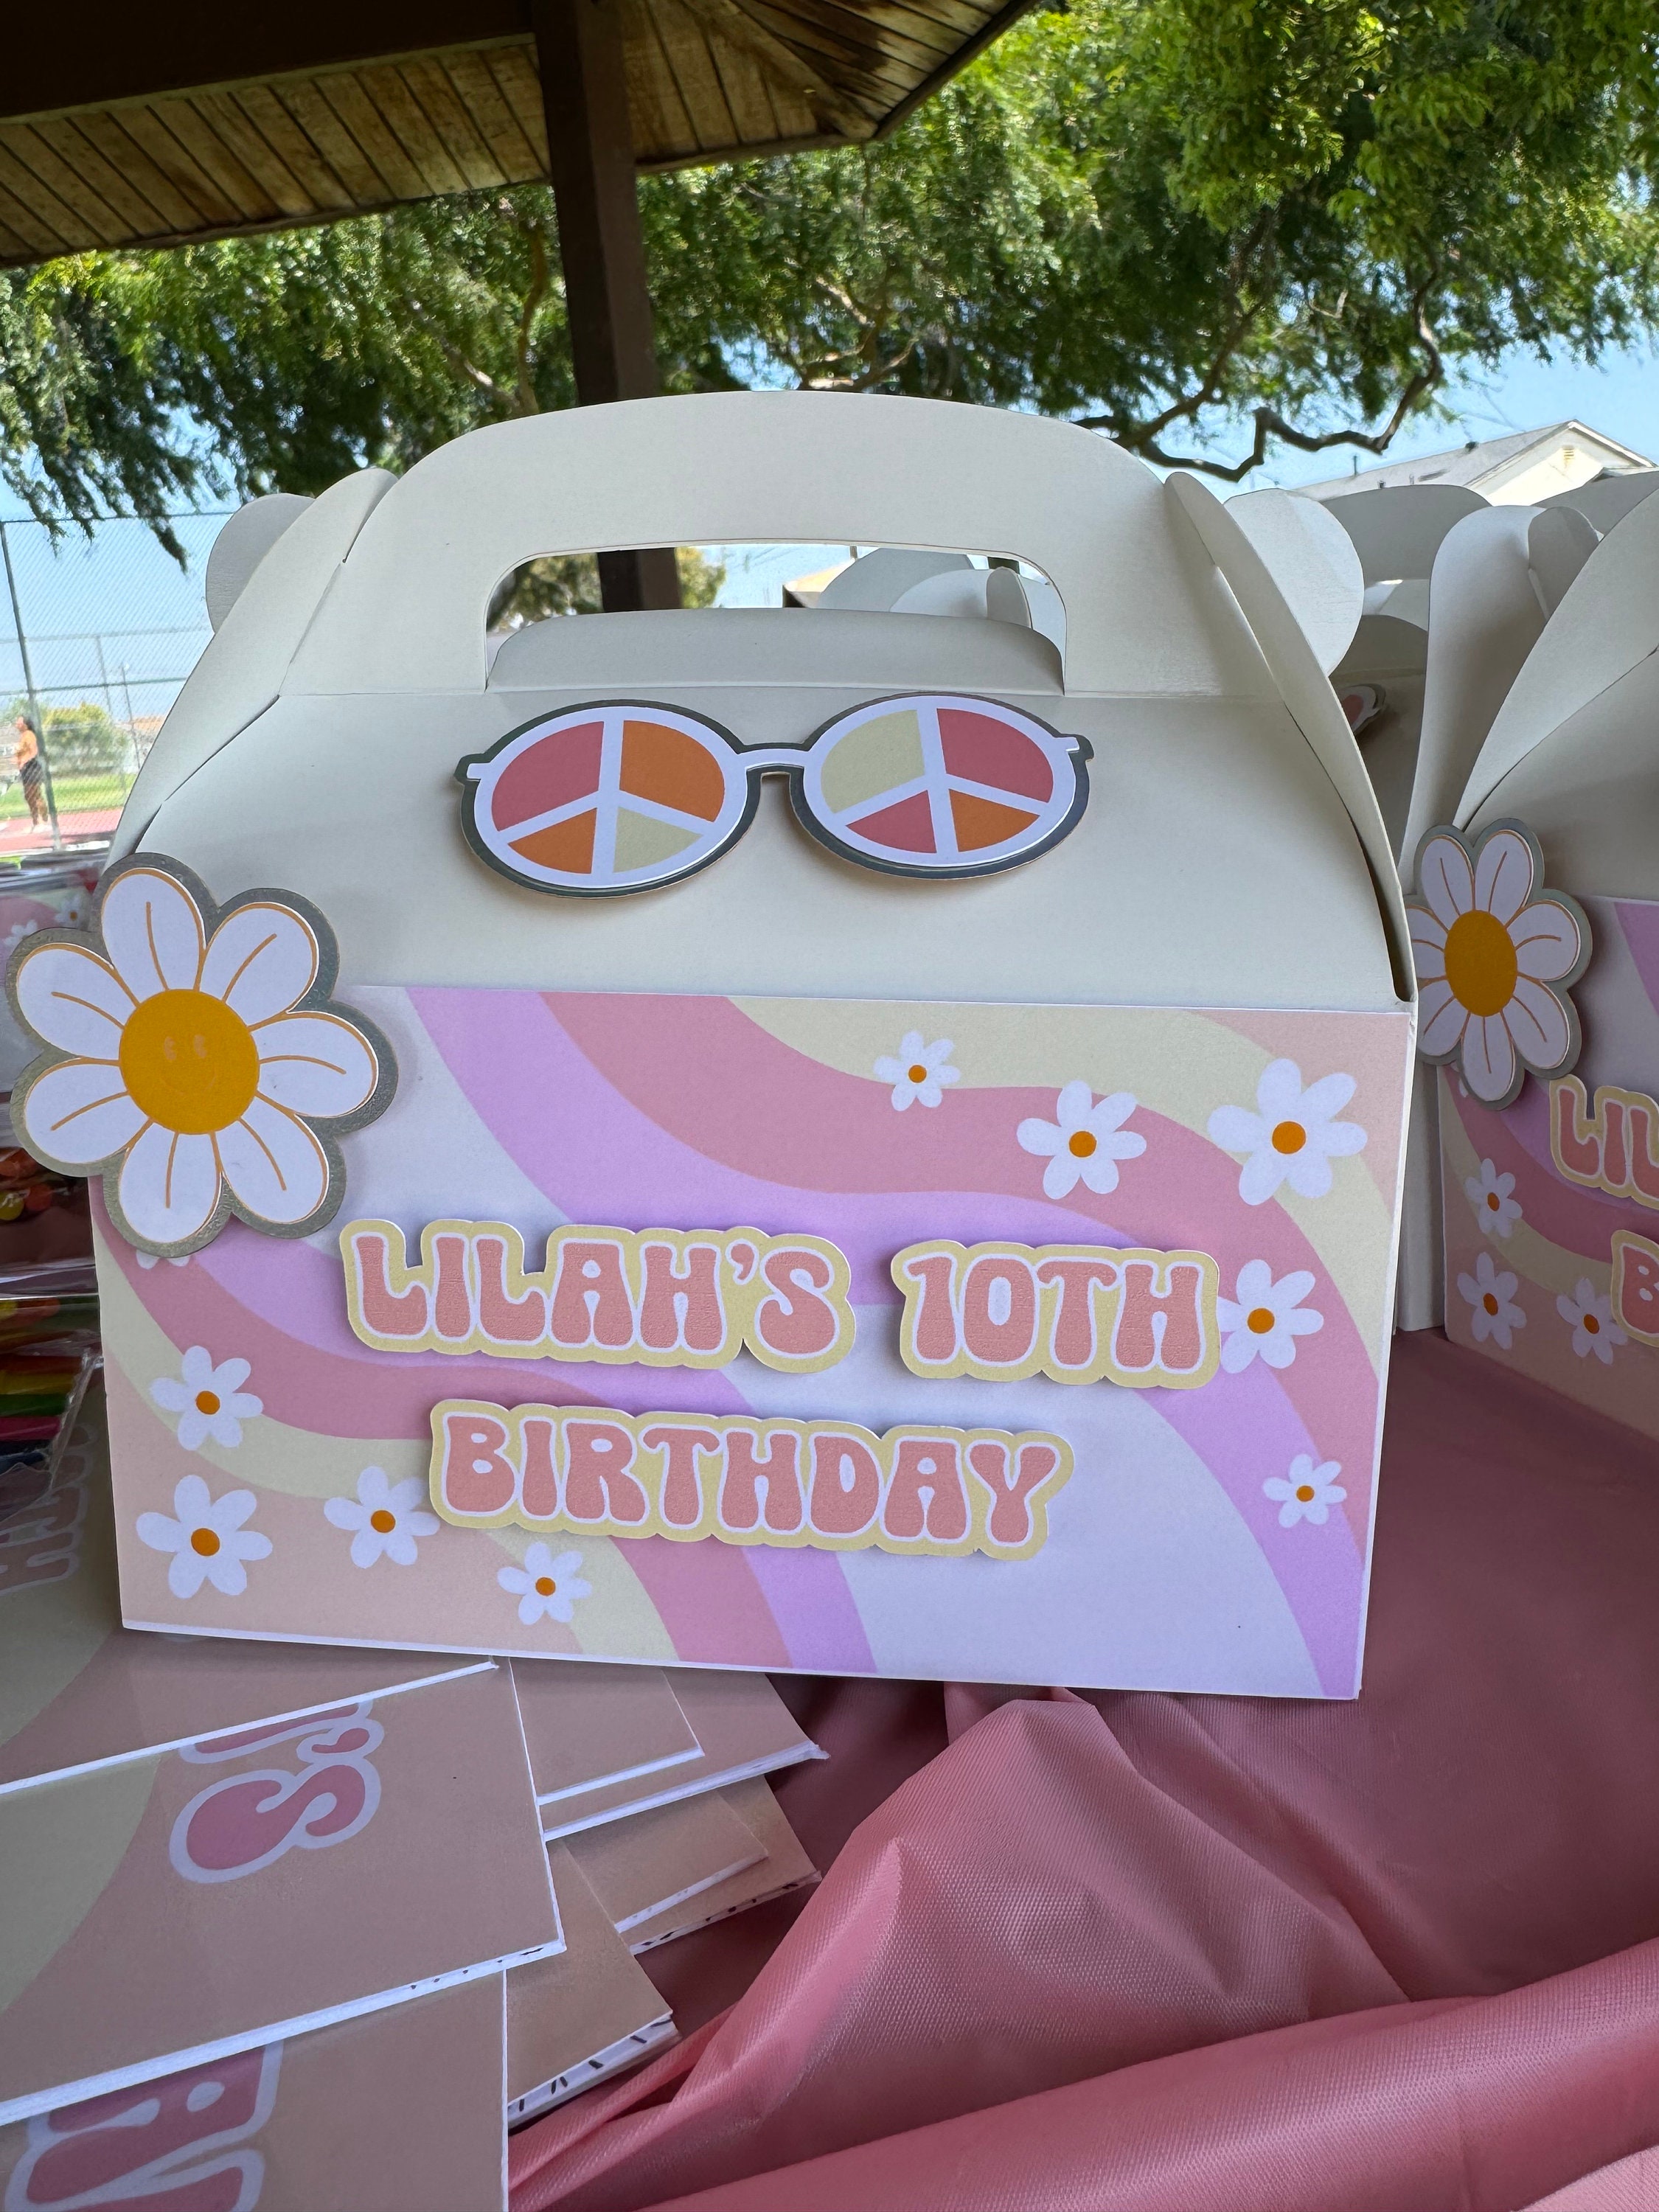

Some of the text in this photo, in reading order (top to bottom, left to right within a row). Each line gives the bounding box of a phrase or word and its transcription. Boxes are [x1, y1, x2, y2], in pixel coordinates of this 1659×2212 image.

[352, 1233, 1203, 1373] LILAH'S 10TH
[444, 1412, 1060, 1545] BIRTHDAY
